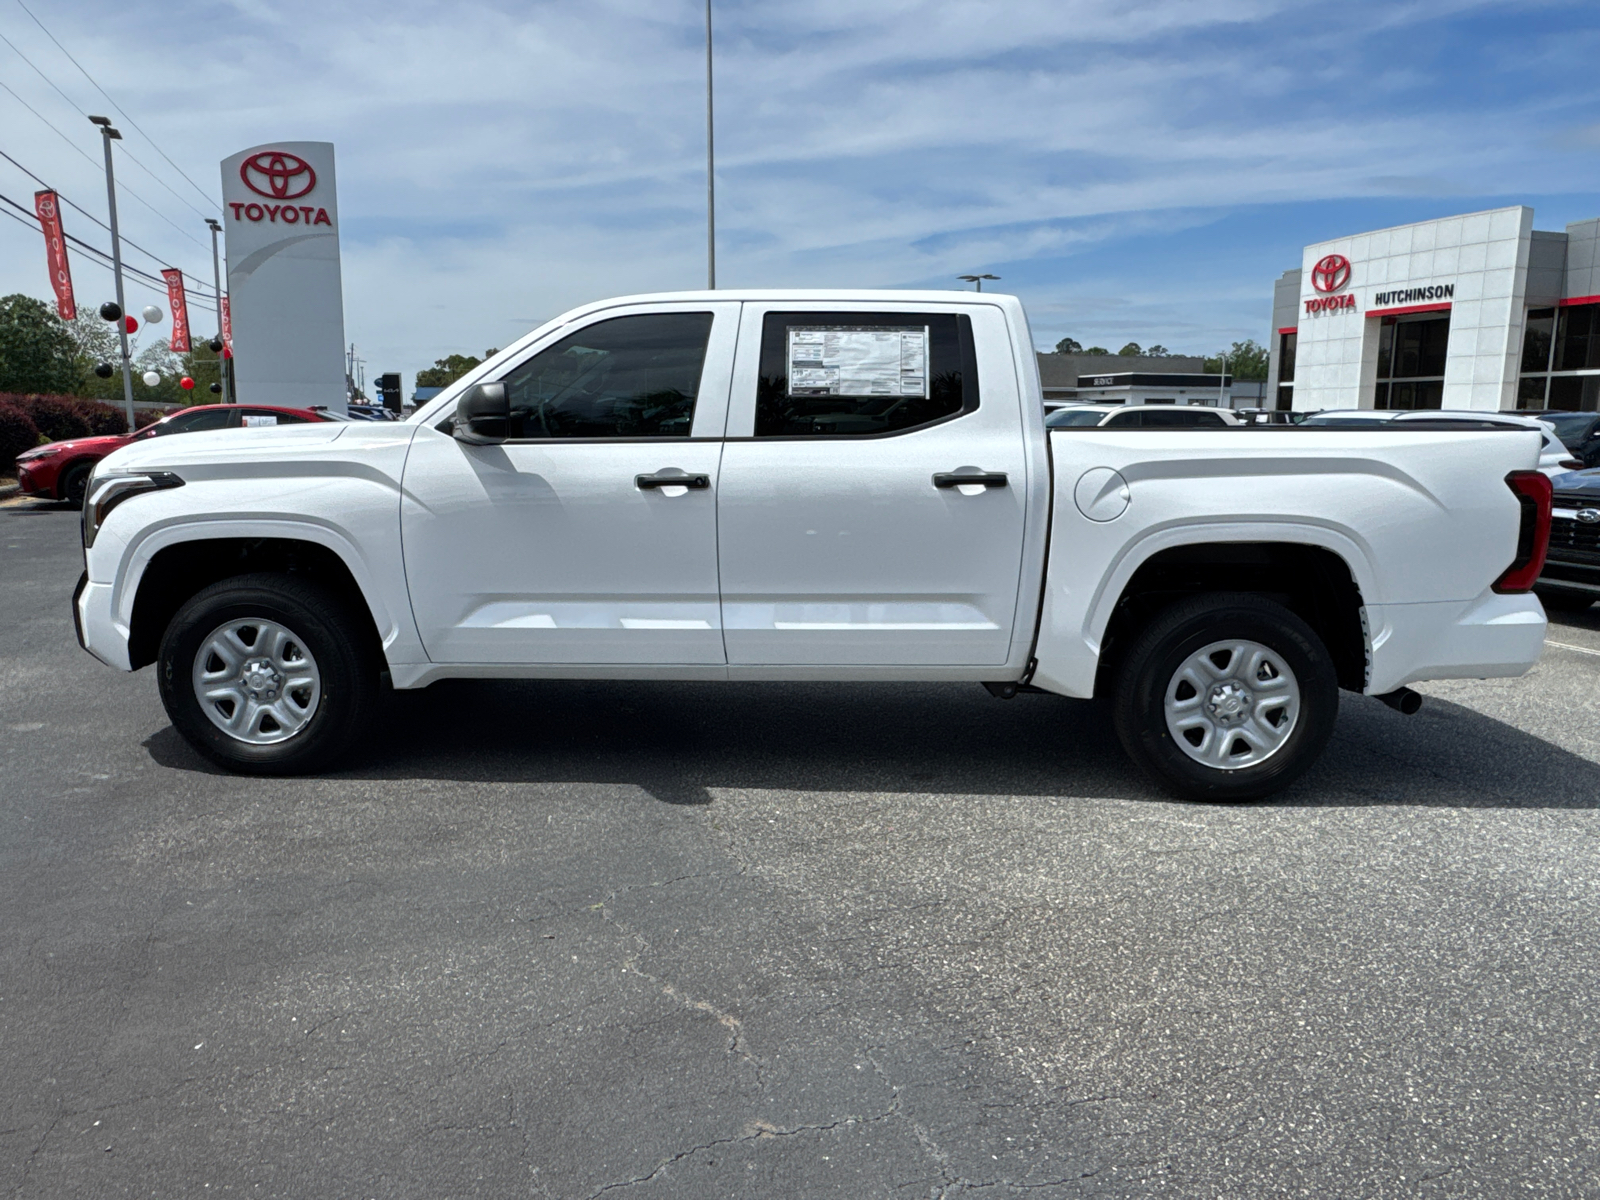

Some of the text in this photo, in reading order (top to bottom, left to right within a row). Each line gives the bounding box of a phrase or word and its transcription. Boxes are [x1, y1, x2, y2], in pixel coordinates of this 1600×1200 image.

[229, 202, 332, 226] TOYOTA
[1304, 294, 1356, 314] TOYOTA
[1375, 284, 1455, 305] HUTCHINSON
[170, 288, 184, 349] TOYOTA
